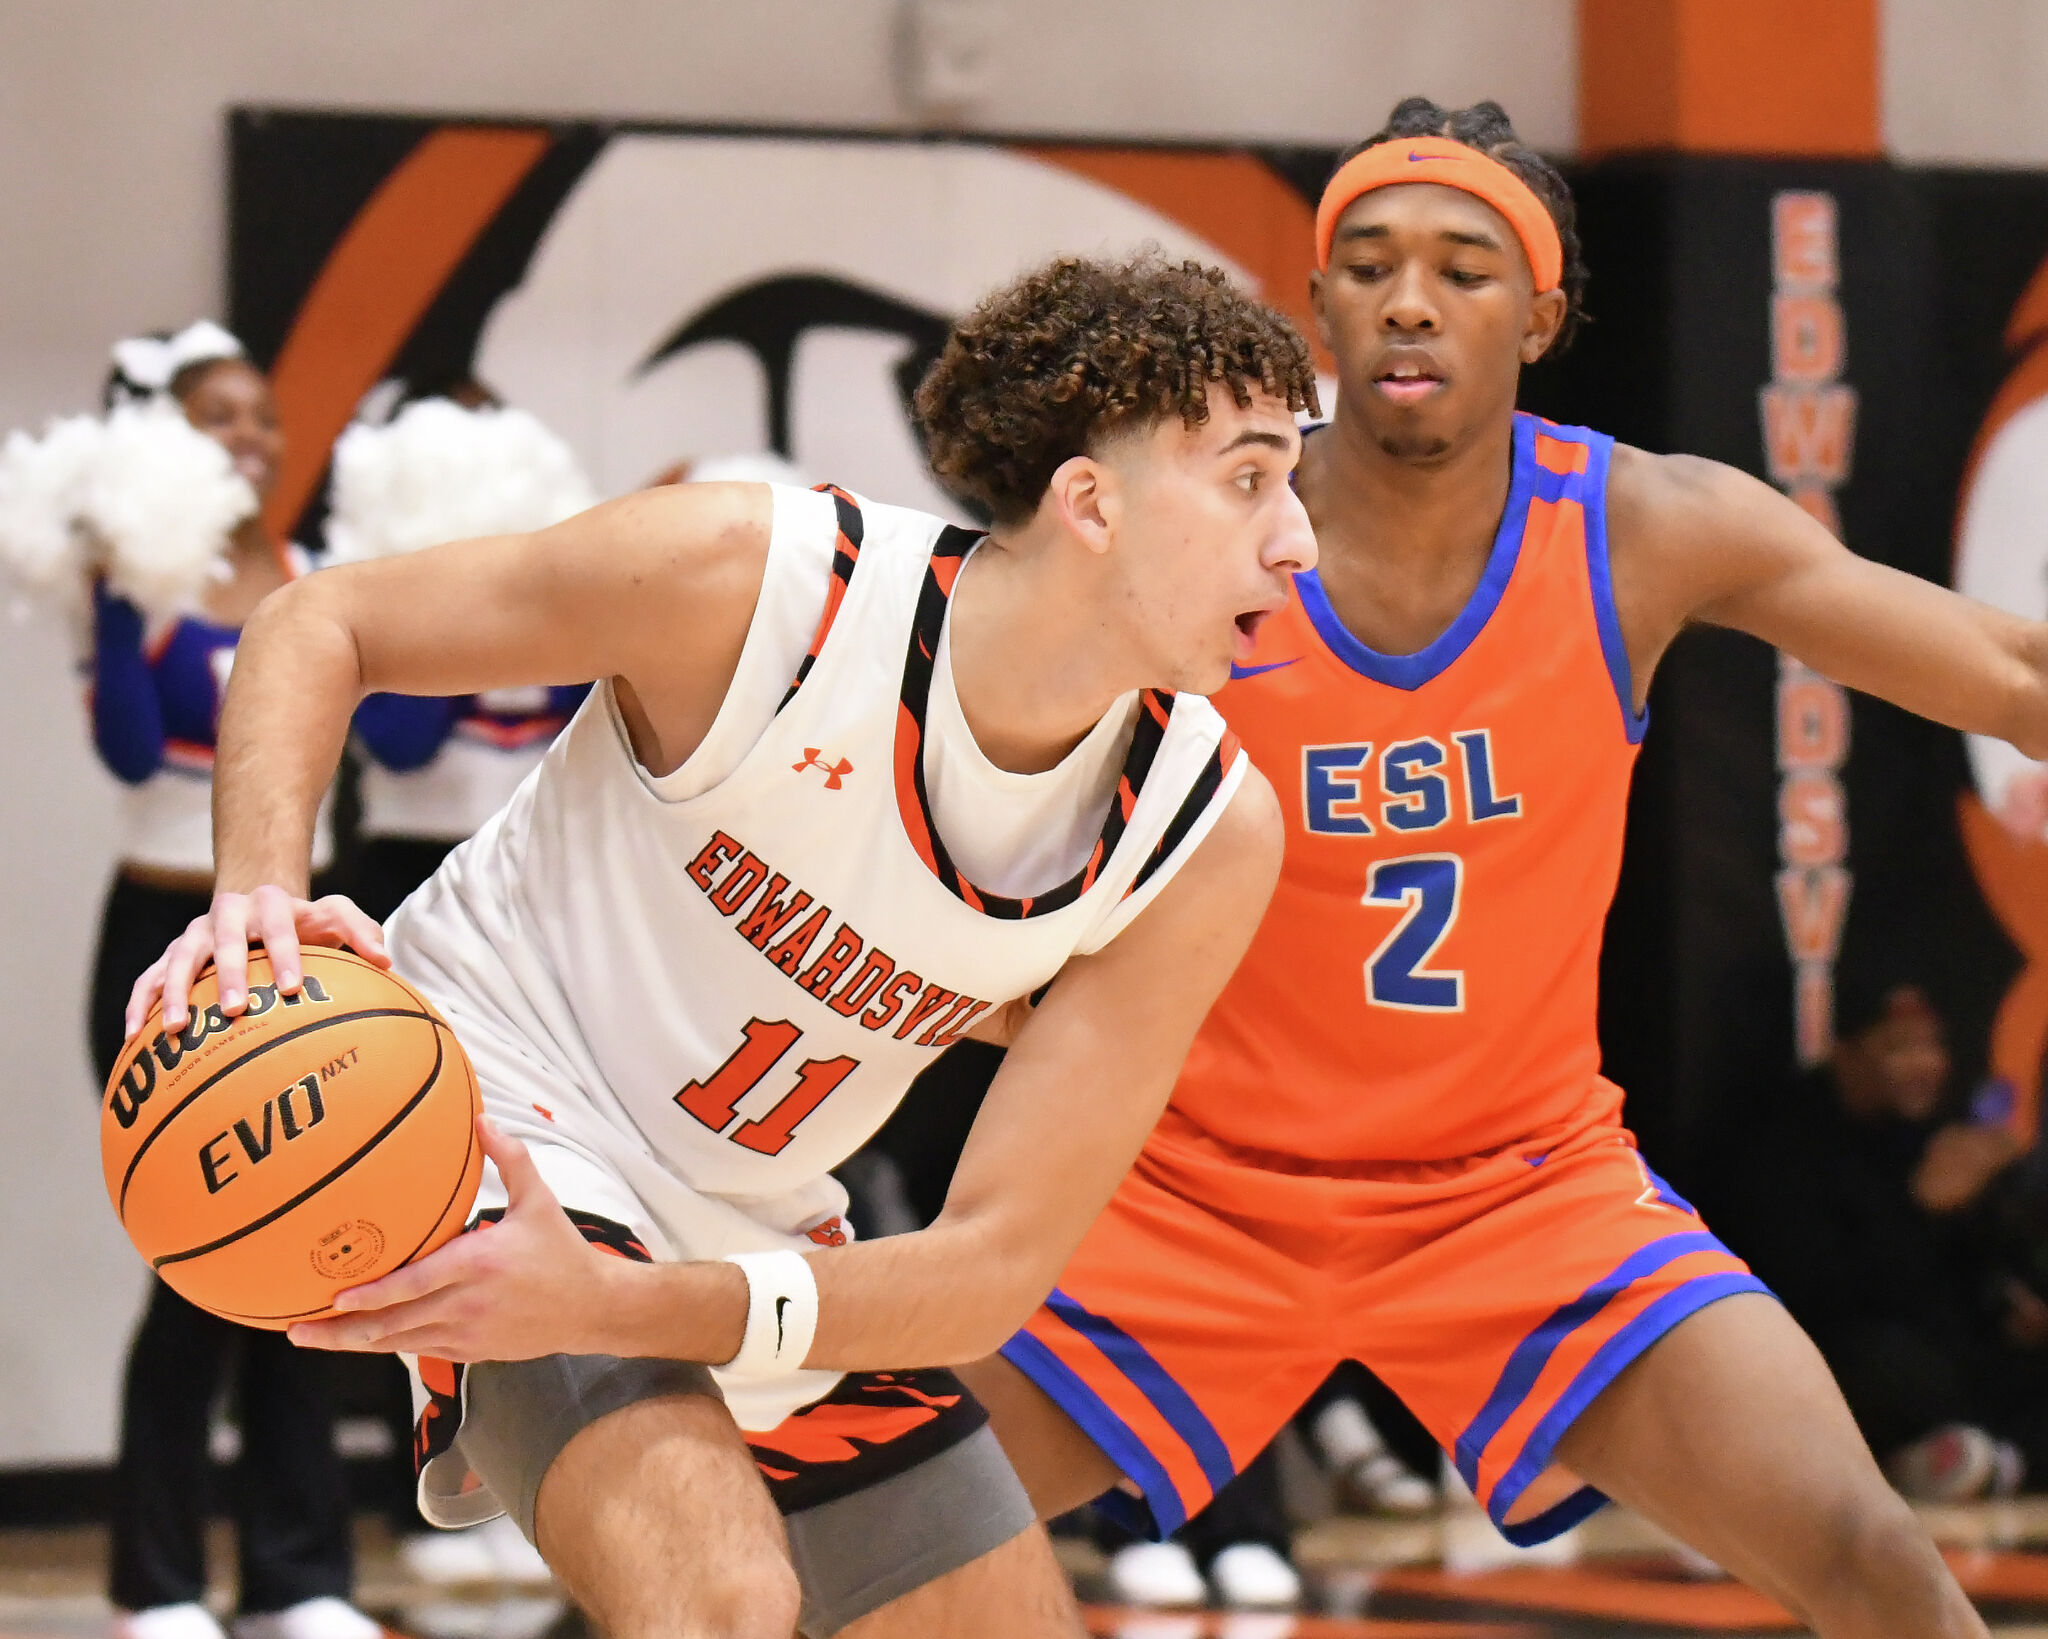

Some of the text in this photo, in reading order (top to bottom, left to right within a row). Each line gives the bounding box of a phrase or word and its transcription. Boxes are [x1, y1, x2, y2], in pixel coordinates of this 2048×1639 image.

[1759, 191, 1858, 1067] EDWDSVI
[1302, 728, 1523, 837] ESL
[1361, 852, 1465, 1013] 2
[198, 1046, 359, 1195] EVO NXT
[672, 1016, 861, 1157] 11
